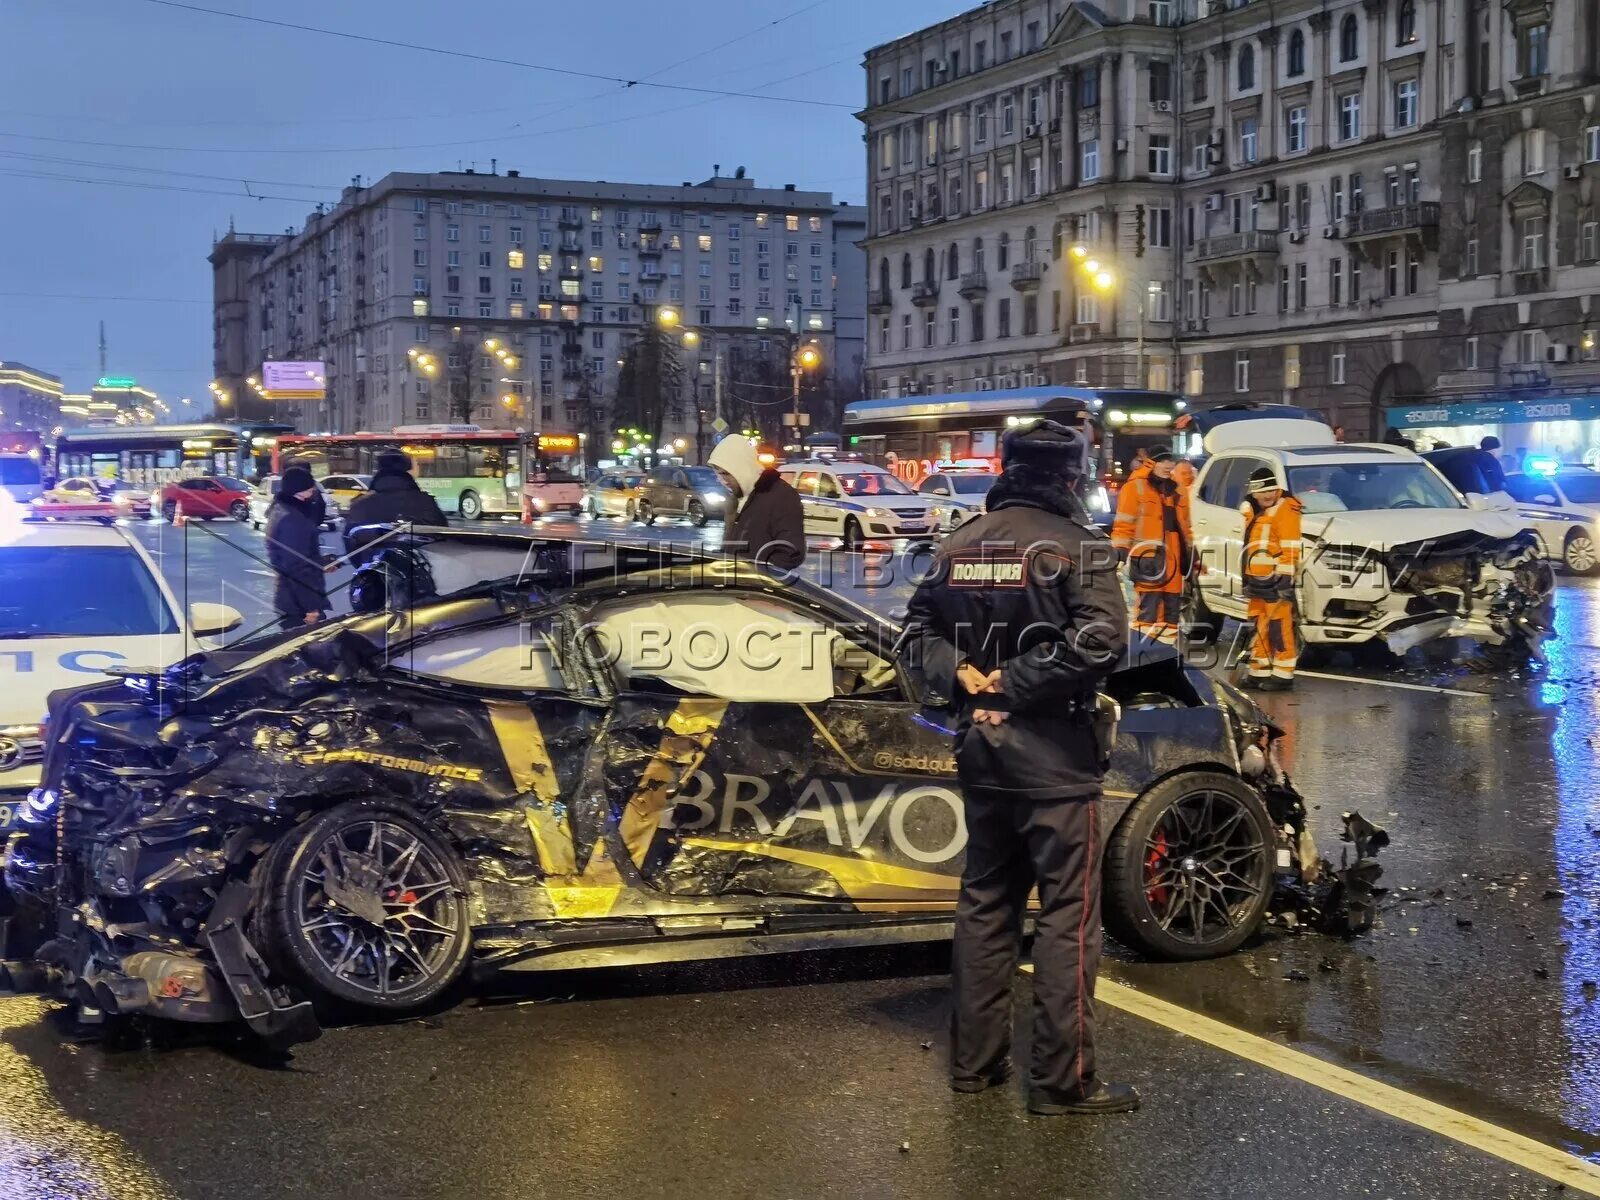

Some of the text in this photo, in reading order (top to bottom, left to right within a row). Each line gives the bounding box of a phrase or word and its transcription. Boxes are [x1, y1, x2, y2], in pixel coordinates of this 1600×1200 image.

[1407, 410, 1449, 423] askona
[1524, 403, 1571, 417] askona
[953, 563, 1023, 583] ПОЛИЦИЯ
[658, 769, 970, 863] BRAVO
